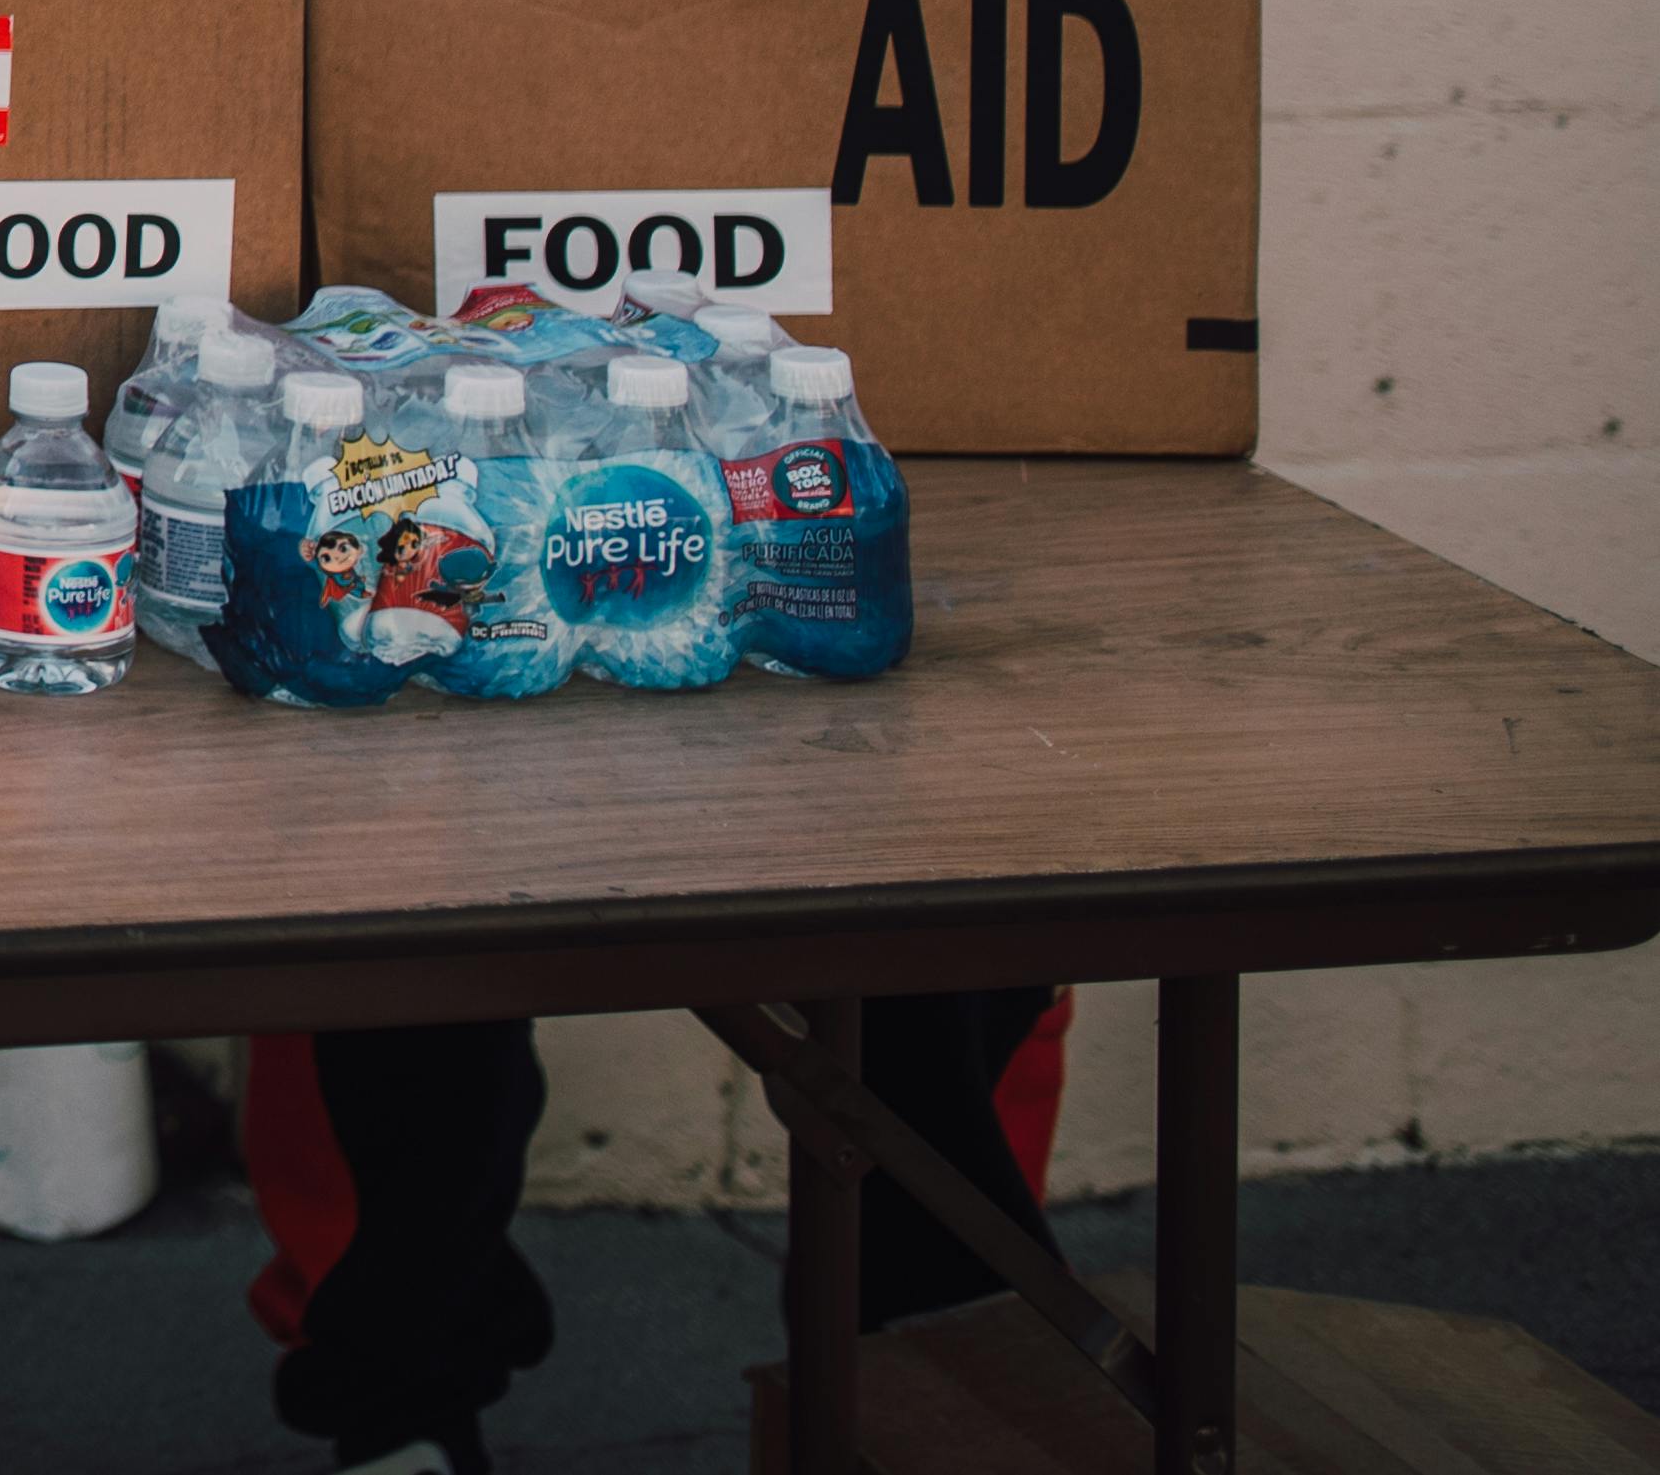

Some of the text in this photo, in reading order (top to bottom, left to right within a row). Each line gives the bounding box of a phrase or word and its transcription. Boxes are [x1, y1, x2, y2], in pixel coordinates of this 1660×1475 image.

[484, 212, 785, 291] FOOD
[785, 463, 823, 483] BOX
[793, 475, 832, 491] TOPS
[564, 498, 669, 534] Nestlé
[803, 528, 855, 545] AGUA
[546, 527, 705, 577] Pure Life
[743, 542, 855, 562] PURIFICADA
[47, 588, 111, 607] Pure Life
